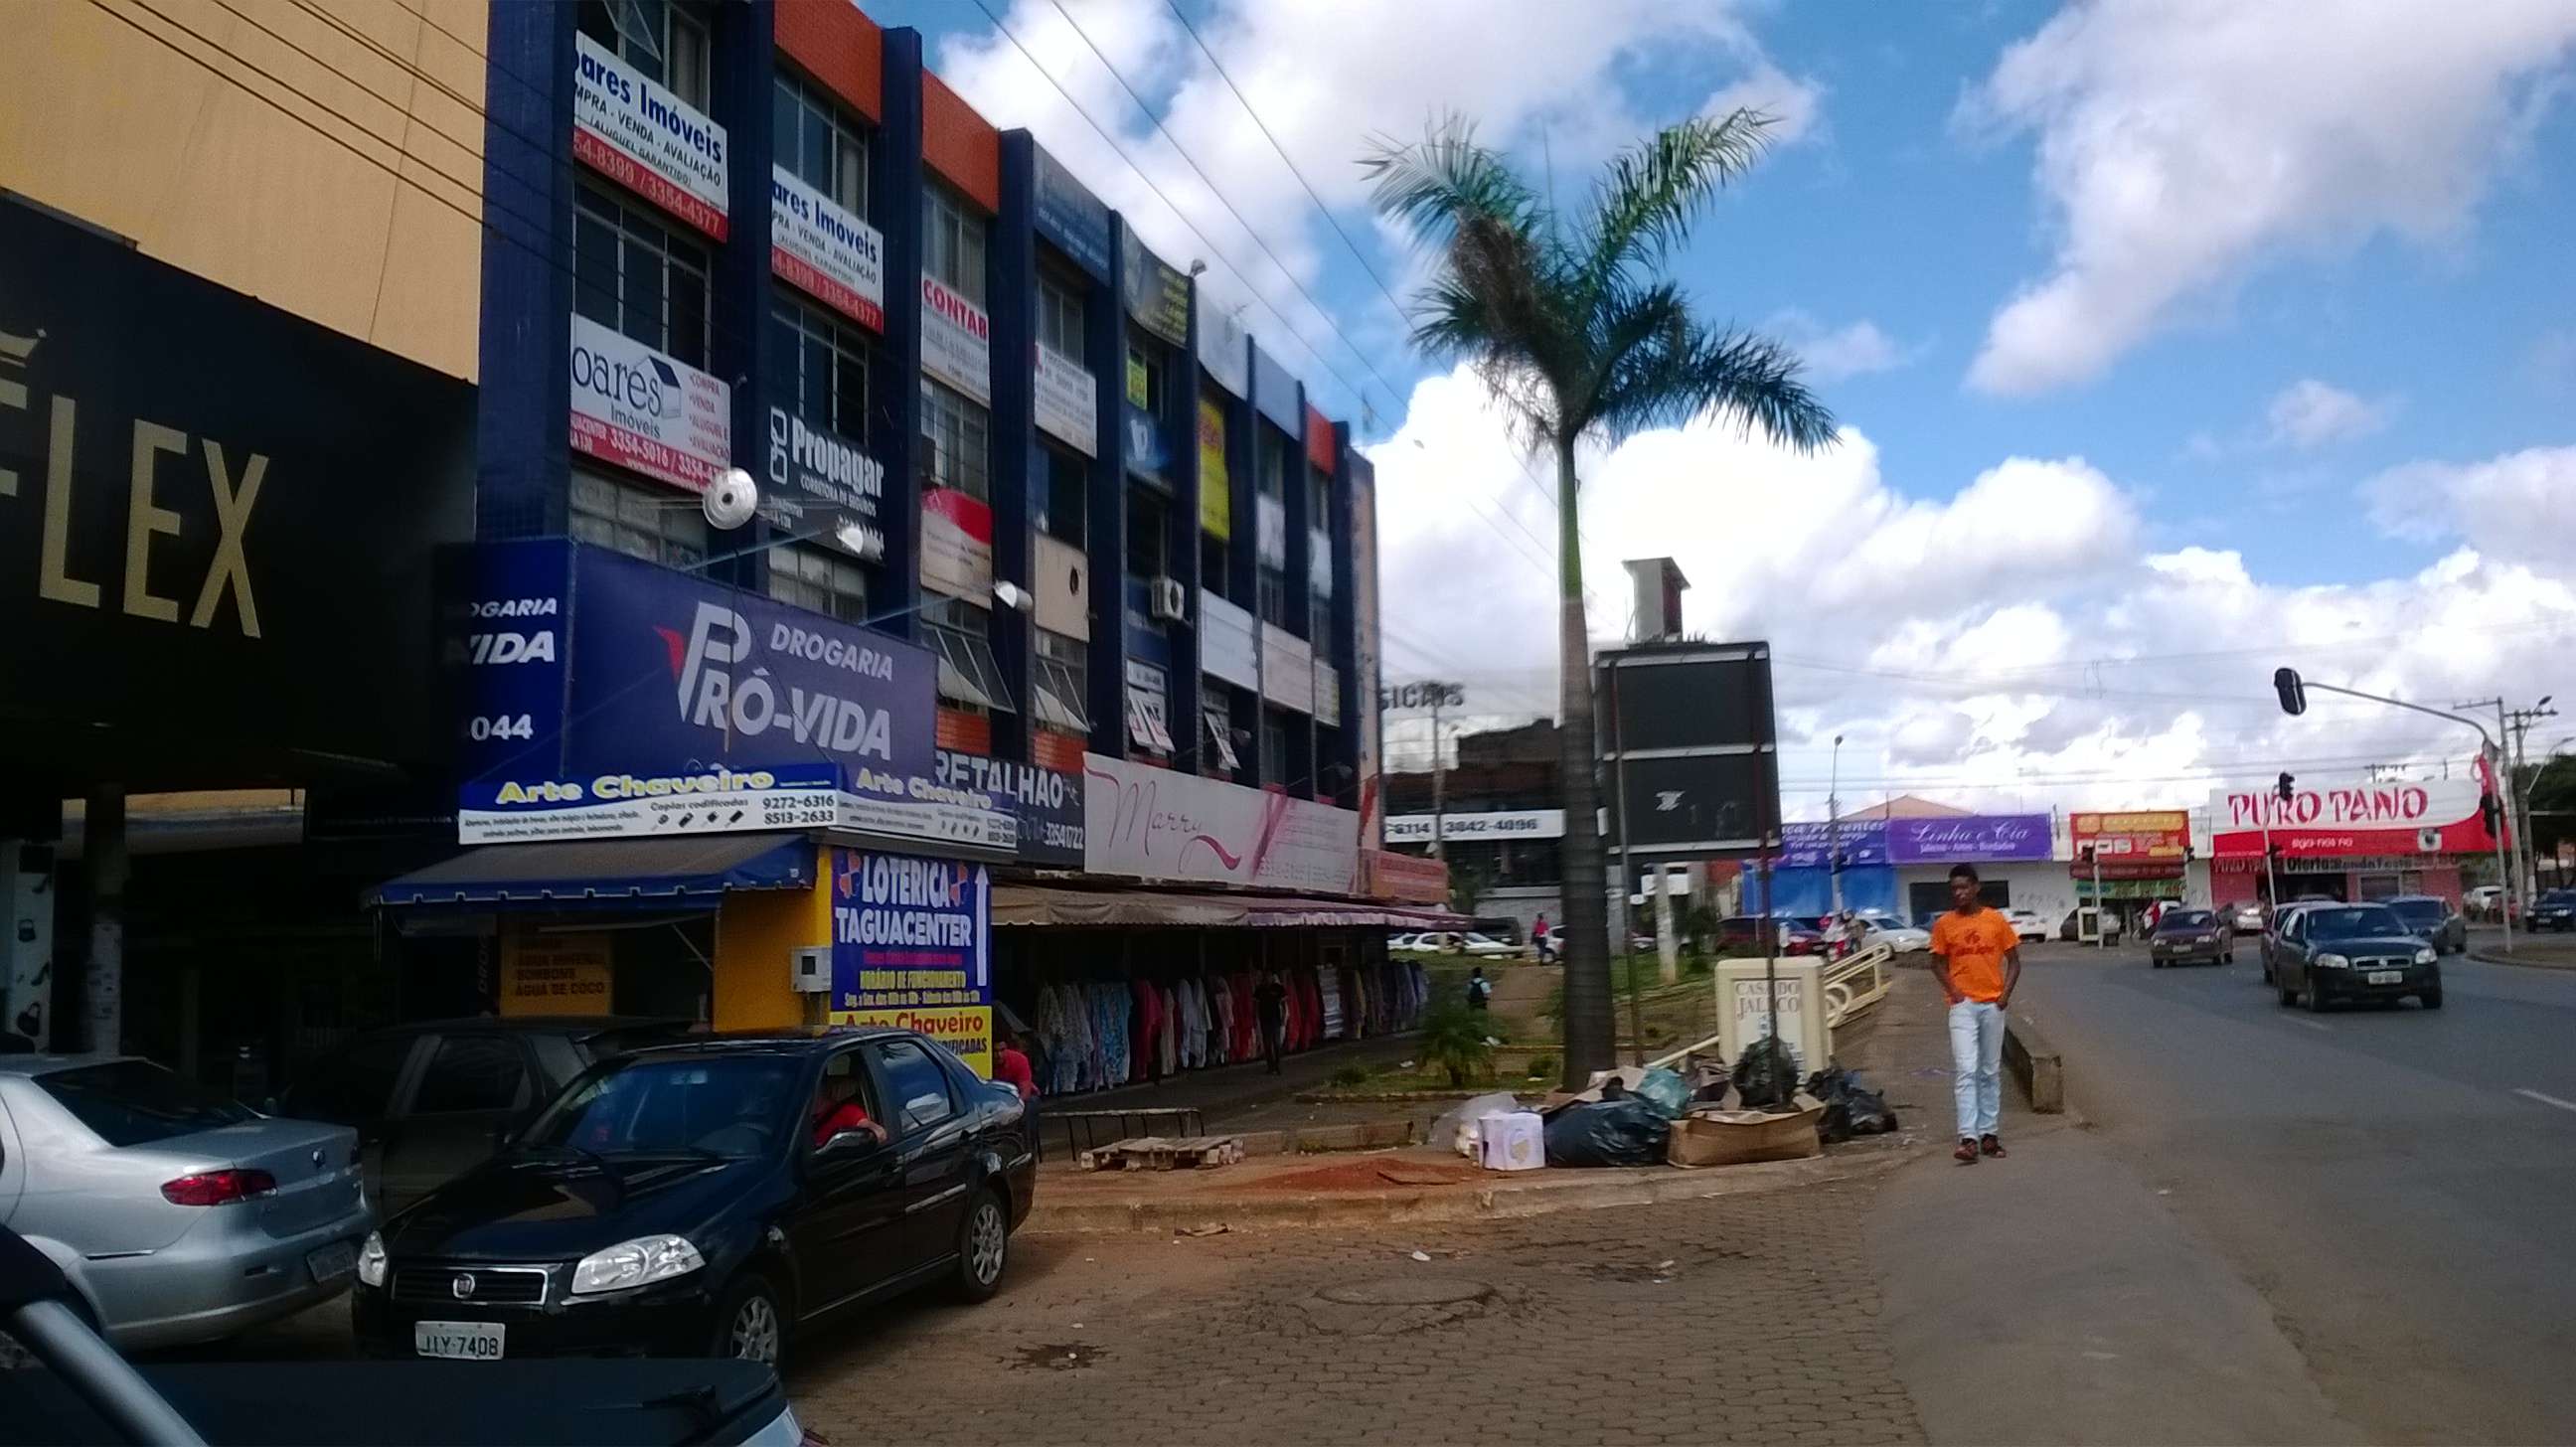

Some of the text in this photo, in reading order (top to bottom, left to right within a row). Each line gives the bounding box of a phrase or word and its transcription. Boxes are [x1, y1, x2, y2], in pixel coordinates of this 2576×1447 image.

[574, 51, 723, 164] ares Imóveis
[574, 83, 722, 187] MPRA VENDA AVALIAÇÃO
[815, 200, 878, 264] Imóveis
[798, 225, 826, 250] VENDA
[833, 247, 877, 285] AVALIAÇÃO
[610, 402, 661, 439] Imóveis
[791, 414, 885, 499] Propagar
[769, 622, 893, 683] DROGARIA
[494, 767, 775, 806] Arte Chaveiro
[761, 796, 835, 811] 9272-6316
[856, 766, 905, 795] Arte
[907, 775, 993, 810] Chaveiro
[2227, 792, 2323, 827] PURO
[2328, 786, 2428, 823] PANO
[764, 811, 835, 826] 8513-2633
[1808, 821, 1886, 835] Prsentes
[1910, 821, 1971, 843] Linha
[835, 906, 973, 947] TAGUACENTER
[1778, 981, 1799, 995] DO
[895, 1011, 984, 1035] Chaveiro
[1735, 997, 1799, 1021] JALCO
